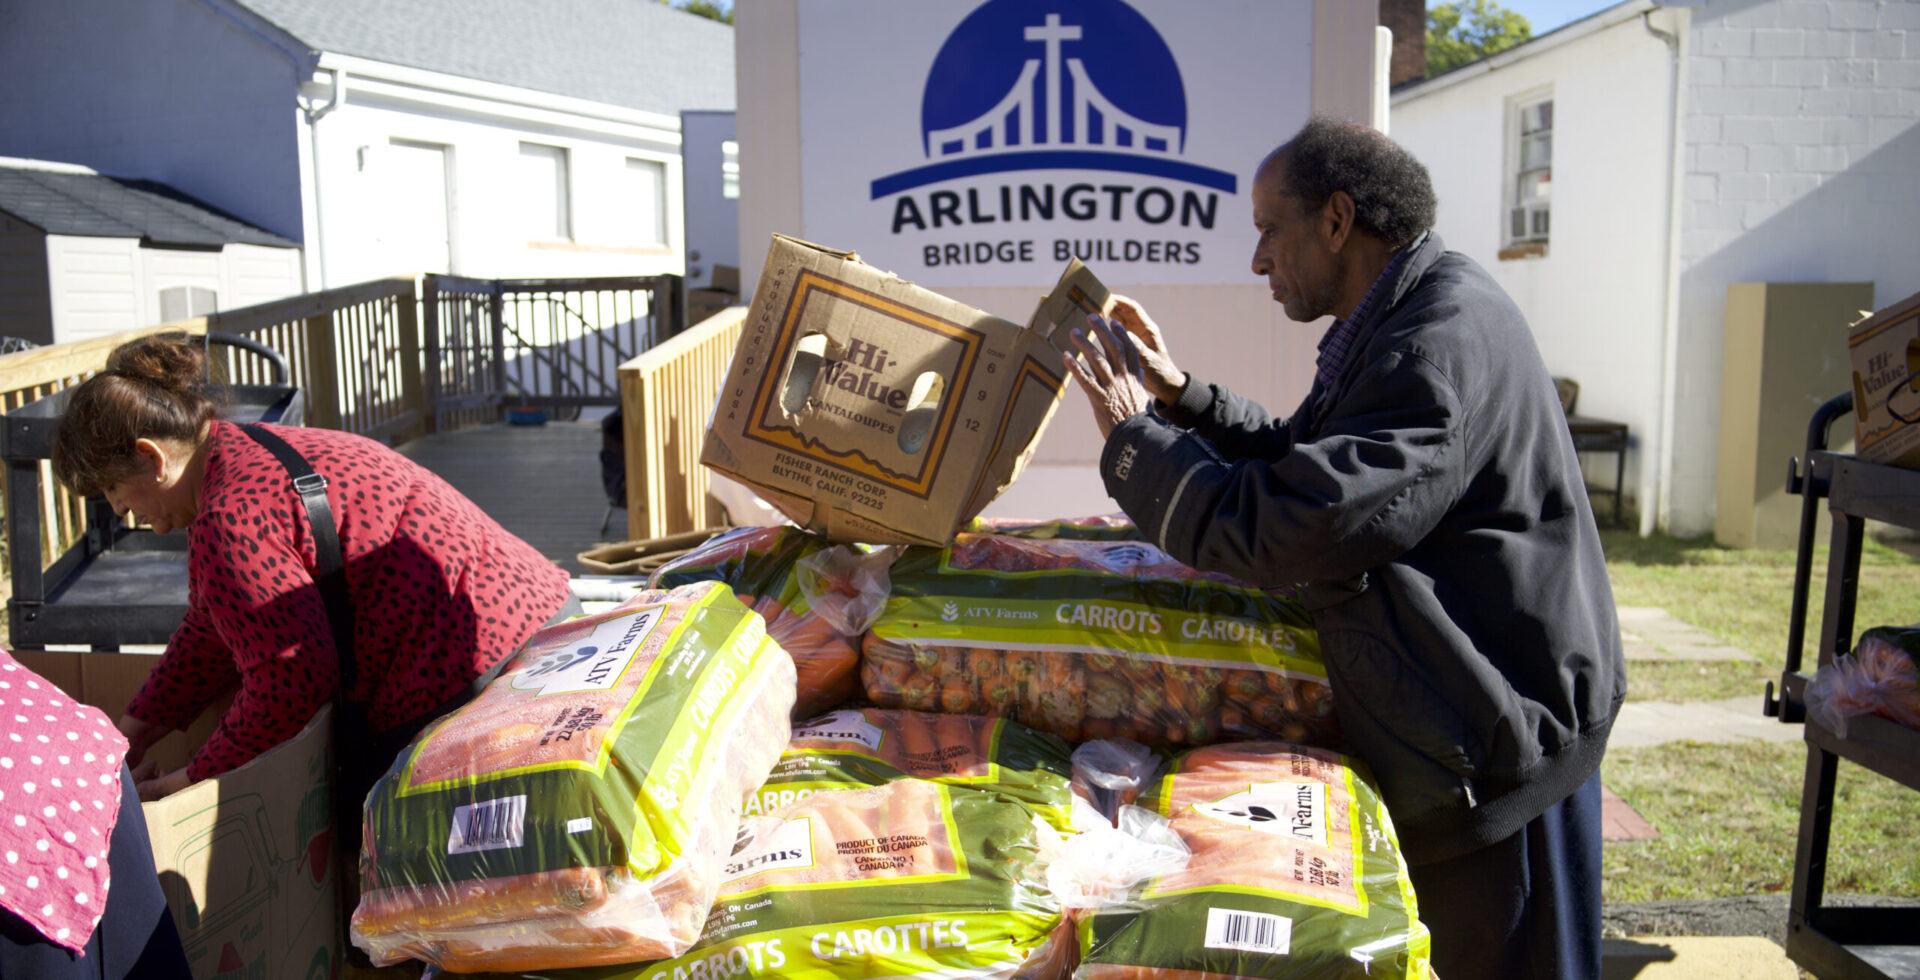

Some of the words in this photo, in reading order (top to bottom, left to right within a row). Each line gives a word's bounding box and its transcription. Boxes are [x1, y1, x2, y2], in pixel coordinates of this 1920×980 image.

[891, 184, 1218, 234] ARLINGTON
[924, 241, 1034, 267] BRIDGE
[1053, 239, 1201, 265] BUILDERS
[743, 356, 756, 376] OF
[847, 338, 897, 374] Hi-
[986, 362, 997, 374] 6
[824, 358, 907, 409] Value
[1863, 363, 1906, 395] Value
[728, 388, 744, 420] USA
[976, 390, 987, 402] 9
[965, 418, 981, 432] 12
[772, 464, 813, 487] BLYTHE,
[816, 479, 848, 498] CALIF.
[850, 490, 885, 511] 92225
[775, 453, 813, 472] FISHER
[815, 465, 854, 487] RANCH
[856, 481, 888, 500] CORP.
[962, 606, 998, 618] ATV
[997, 607, 1039, 620] Farms
[1056, 603, 1162, 634] CARROTS
[1181, 617, 1297, 651] CAROTTES
[584, 655, 619, 685] ATV
[606, 613, 650, 655] Farms
[691, 659, 737, 730] CARROTS
[741, 787, 826, 816] ARRO
[1291, 784, 1313, 826] Farms
[836, 838, 875, 850] PRODUCT
[876, 837, 889, 845] OF
[890, 834, 927, 842] CANADA
[837, 847, 875, 855] PRODUIT
[876, 845, 890, 854] DU
[891, 841, 928, 852] CANADA
[723, 848, 803, 876] arms
[858, 861, 896, 872] CANADA
[722, 914, 736, 924] 1P6
[728, 904, 742, 913] ON
[744, 898, 773, 912] Canada
[810, 919, 969, 961] CAROTTES
